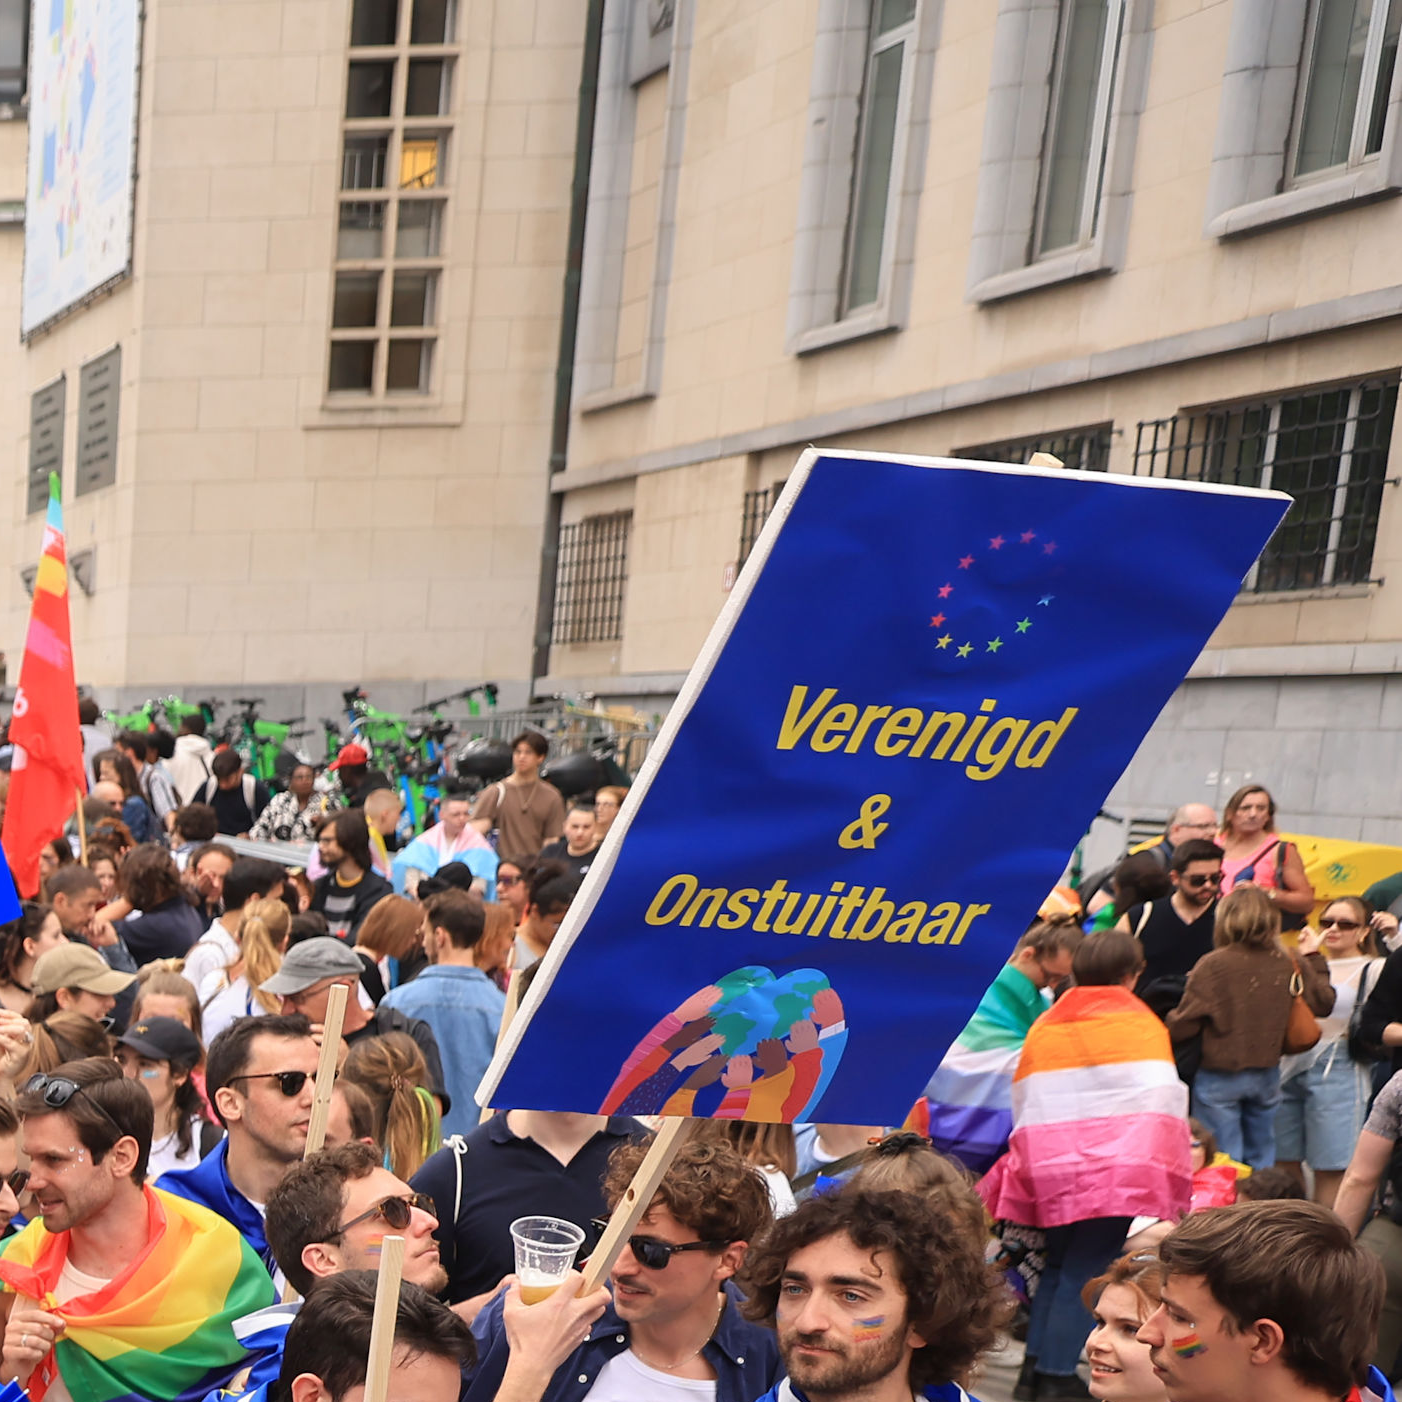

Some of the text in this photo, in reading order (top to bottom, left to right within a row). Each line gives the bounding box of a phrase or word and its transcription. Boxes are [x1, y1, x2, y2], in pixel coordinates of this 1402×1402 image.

[776, 685, 1079, 781] Verenigd
[837, 793, 892, 849] &
[644, 874, 991, 945] Onstuitbaar
